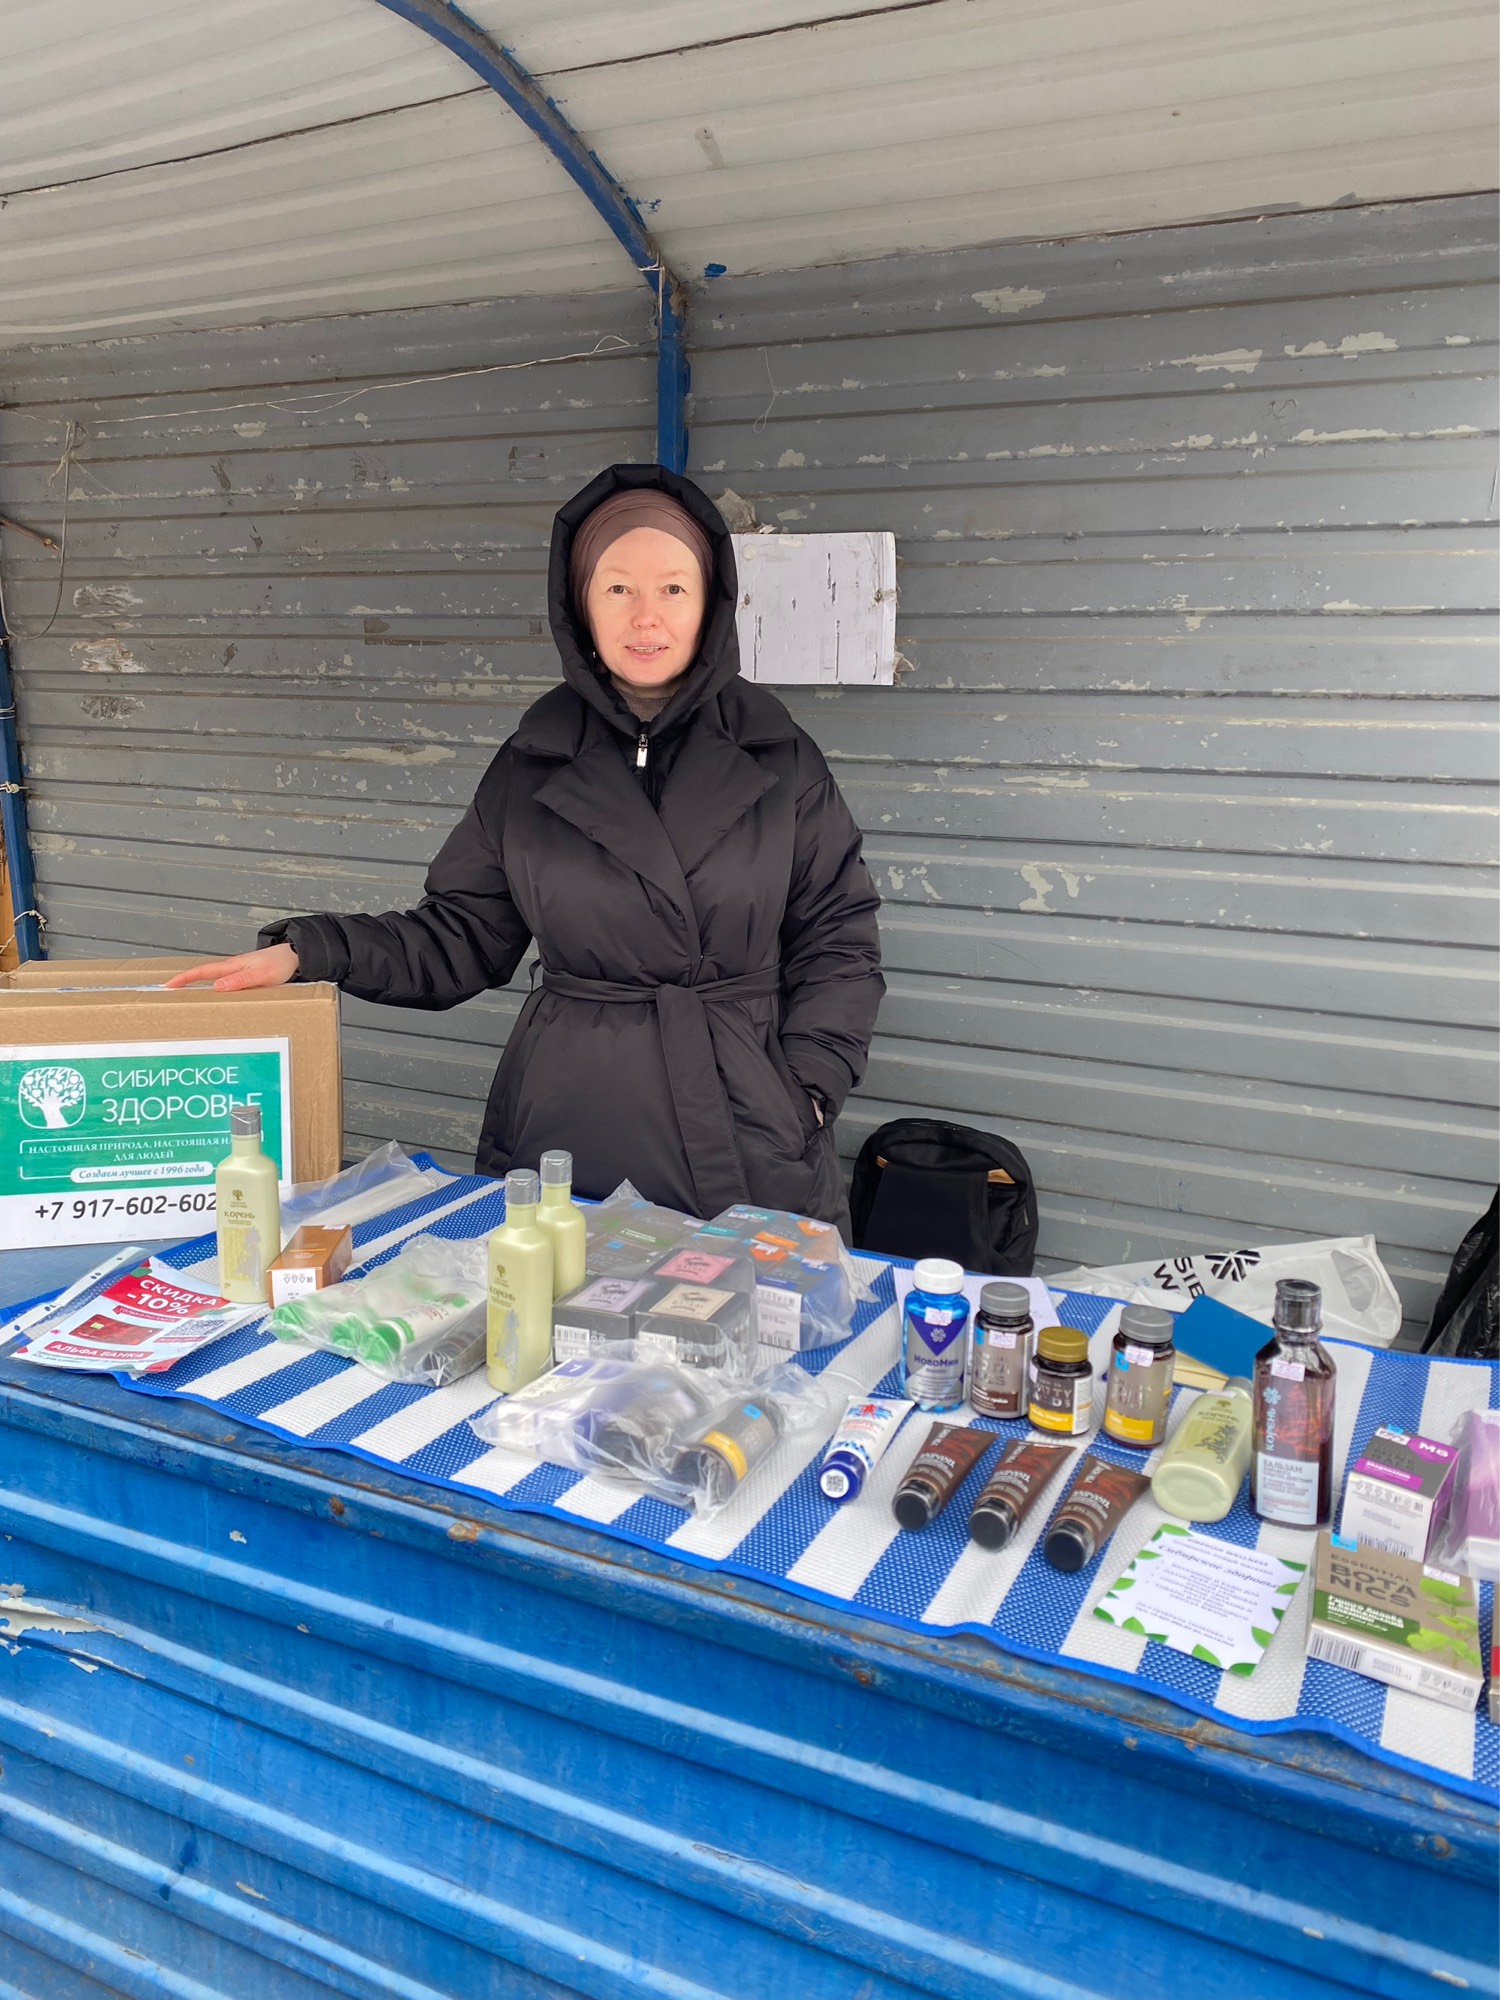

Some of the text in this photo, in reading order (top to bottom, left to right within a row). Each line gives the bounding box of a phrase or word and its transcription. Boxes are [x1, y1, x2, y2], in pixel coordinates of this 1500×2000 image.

[101, 1066, 239, 1089] СИБИРСКОЕ
[29, 1142, 97, 1155] НАСТОЯЩАЯ
[154, 1137, 219, 1149] НАСТОЯЩАЯ
[113, 1150, 174, 1162] ДЛЯ ЛЮДЕЙ
[79, 1167, 117, 1179] Создаем
[119, 1167, 152, 1178] лучшее
[160, 1165, 184, 1174] 1996
[185, 1163, 205, 1174] года
[35, 1202, 63, 1220] +7
[139, 1279, 217, 1306] СКИДКА
[127, 1293, 191, 1315] -10%
[50, 1343, 98, 1356] АЛЬФА
[99, 1350, 145, 1358] БАНКА
[1331, 1553, 1409, 1582] ESSENTIAL
[1330, 1574, 1411, 1608] NICS
[1331, 1562, 1418, 1600] BOTA
